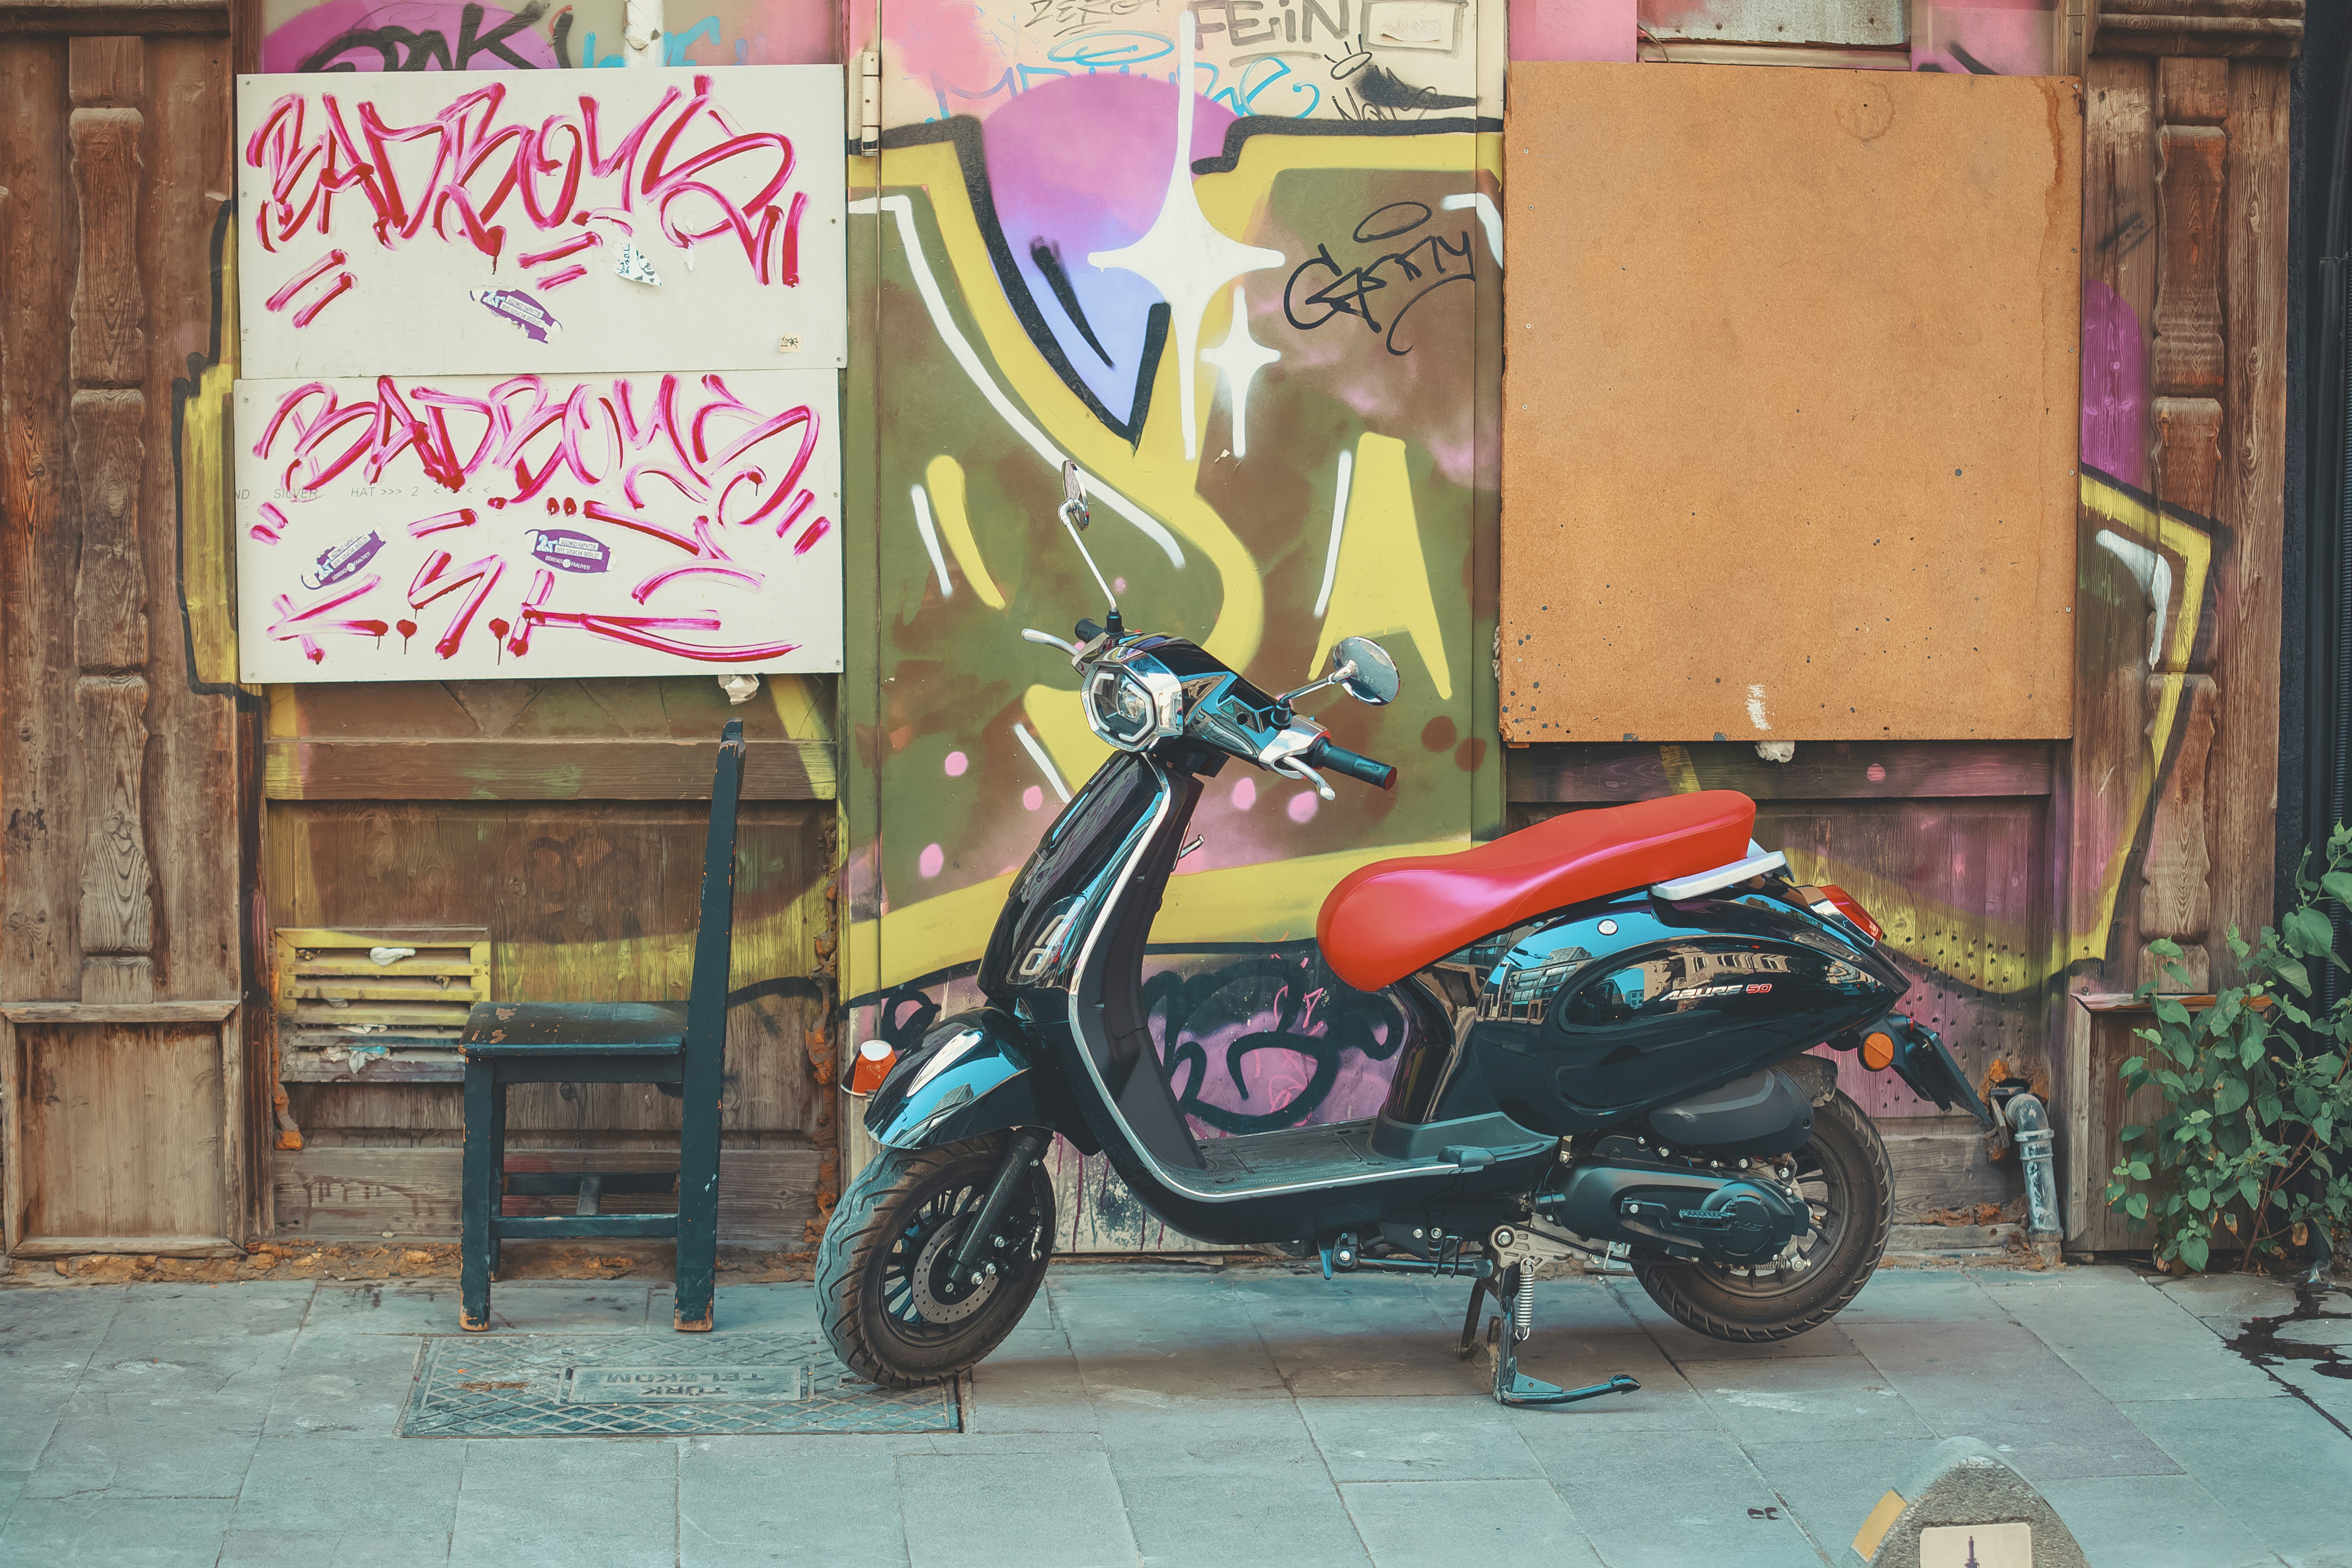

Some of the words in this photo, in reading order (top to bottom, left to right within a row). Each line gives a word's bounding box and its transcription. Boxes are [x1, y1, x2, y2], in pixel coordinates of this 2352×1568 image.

[511, 308, 526, 319] SUSACAK
[523, 305, 541, 318] KAPATTIK
[273, 488, 318, 499] SILVER
[351, 487, 376, 497] HAT
[545, 555, 563, 564] ÖĞRENCİ
[1659, 984, 1743, 1001] AZURE
[1746, 983, 1773, 993] 50
[606, 1372, 765, 1383] TELEKOM
[640, 1386, 729, 1396] TÜRK
